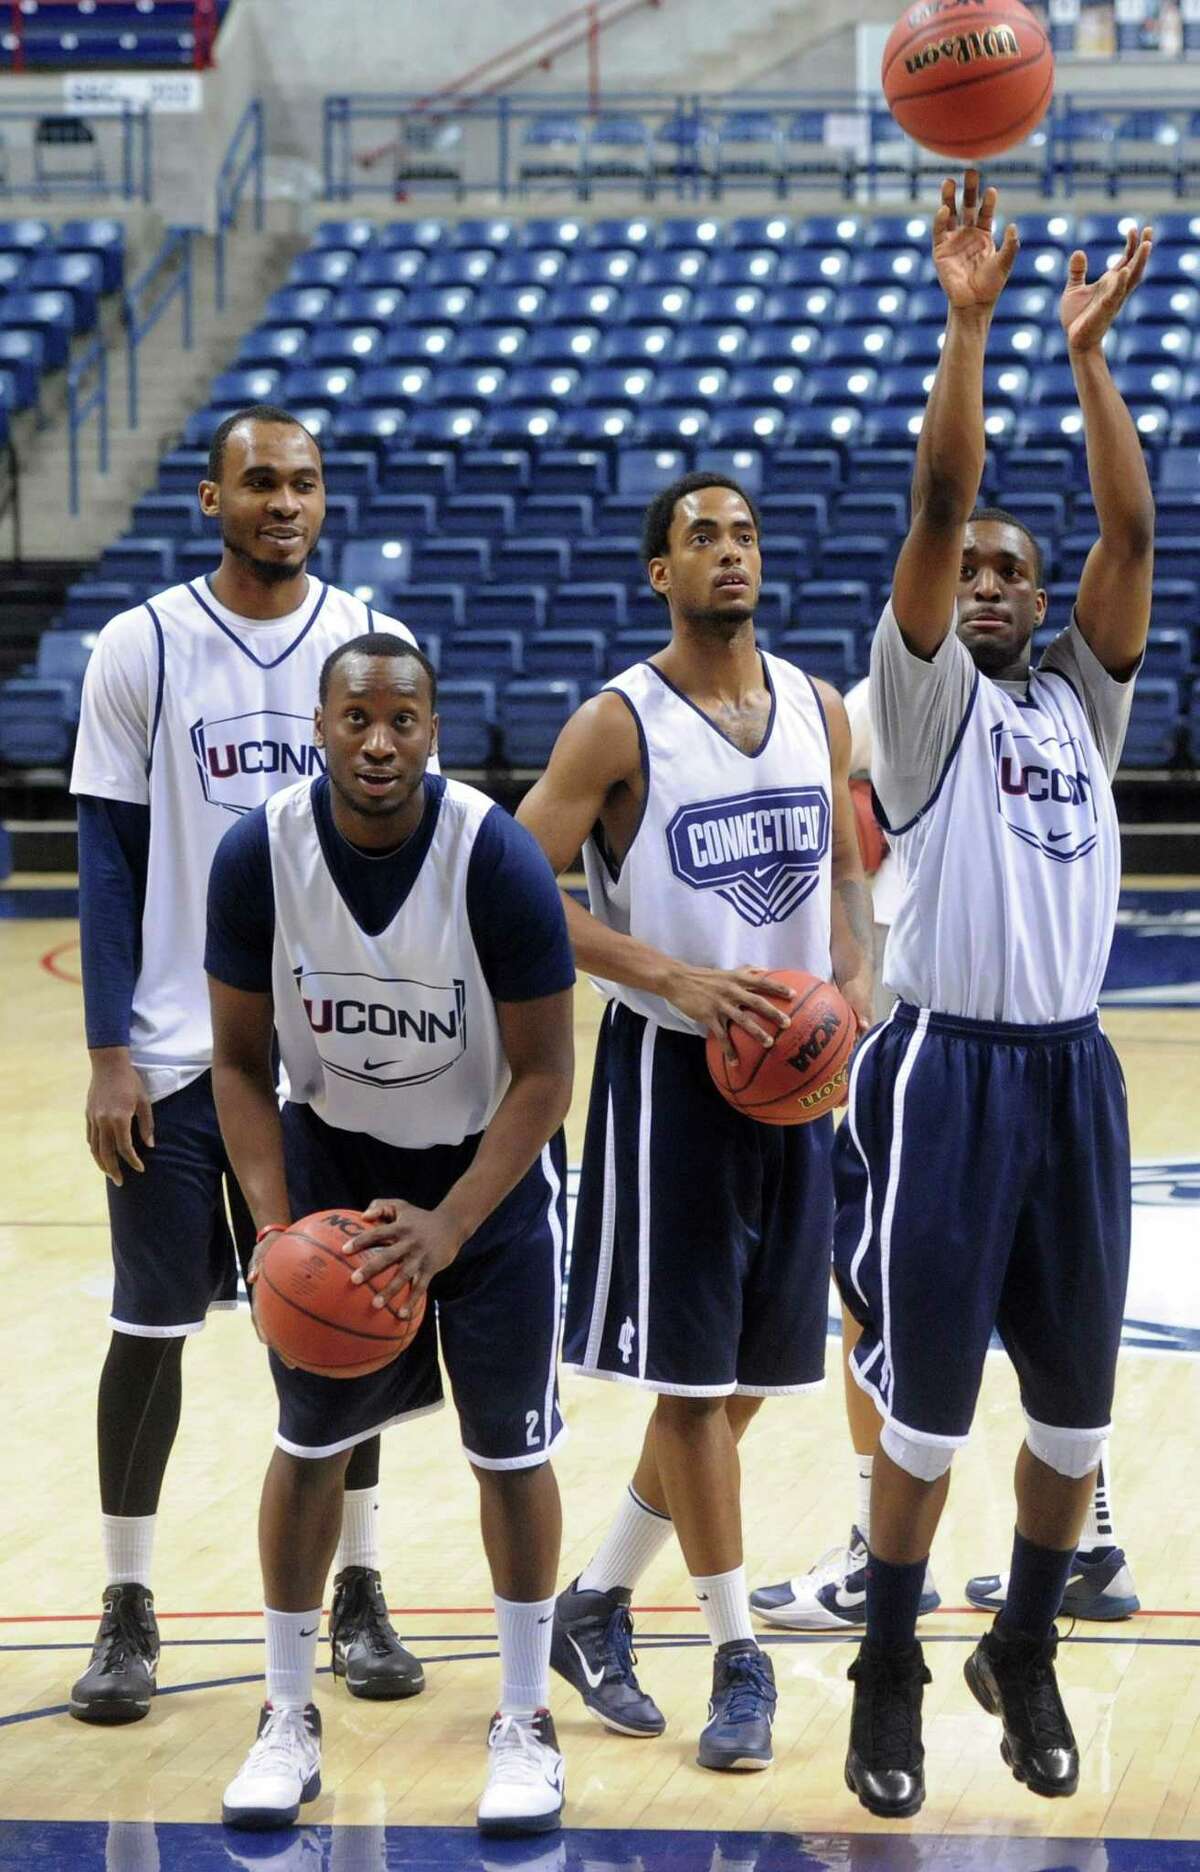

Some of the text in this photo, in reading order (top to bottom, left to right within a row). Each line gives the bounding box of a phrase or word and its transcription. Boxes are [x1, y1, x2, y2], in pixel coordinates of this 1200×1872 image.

[905, 24, 1021, 74] Wilson
[303, 999, 457, 1043] UCONN
[321, 1215, 365, 1236] NC
[525, 1409, 541, 1447] 2
